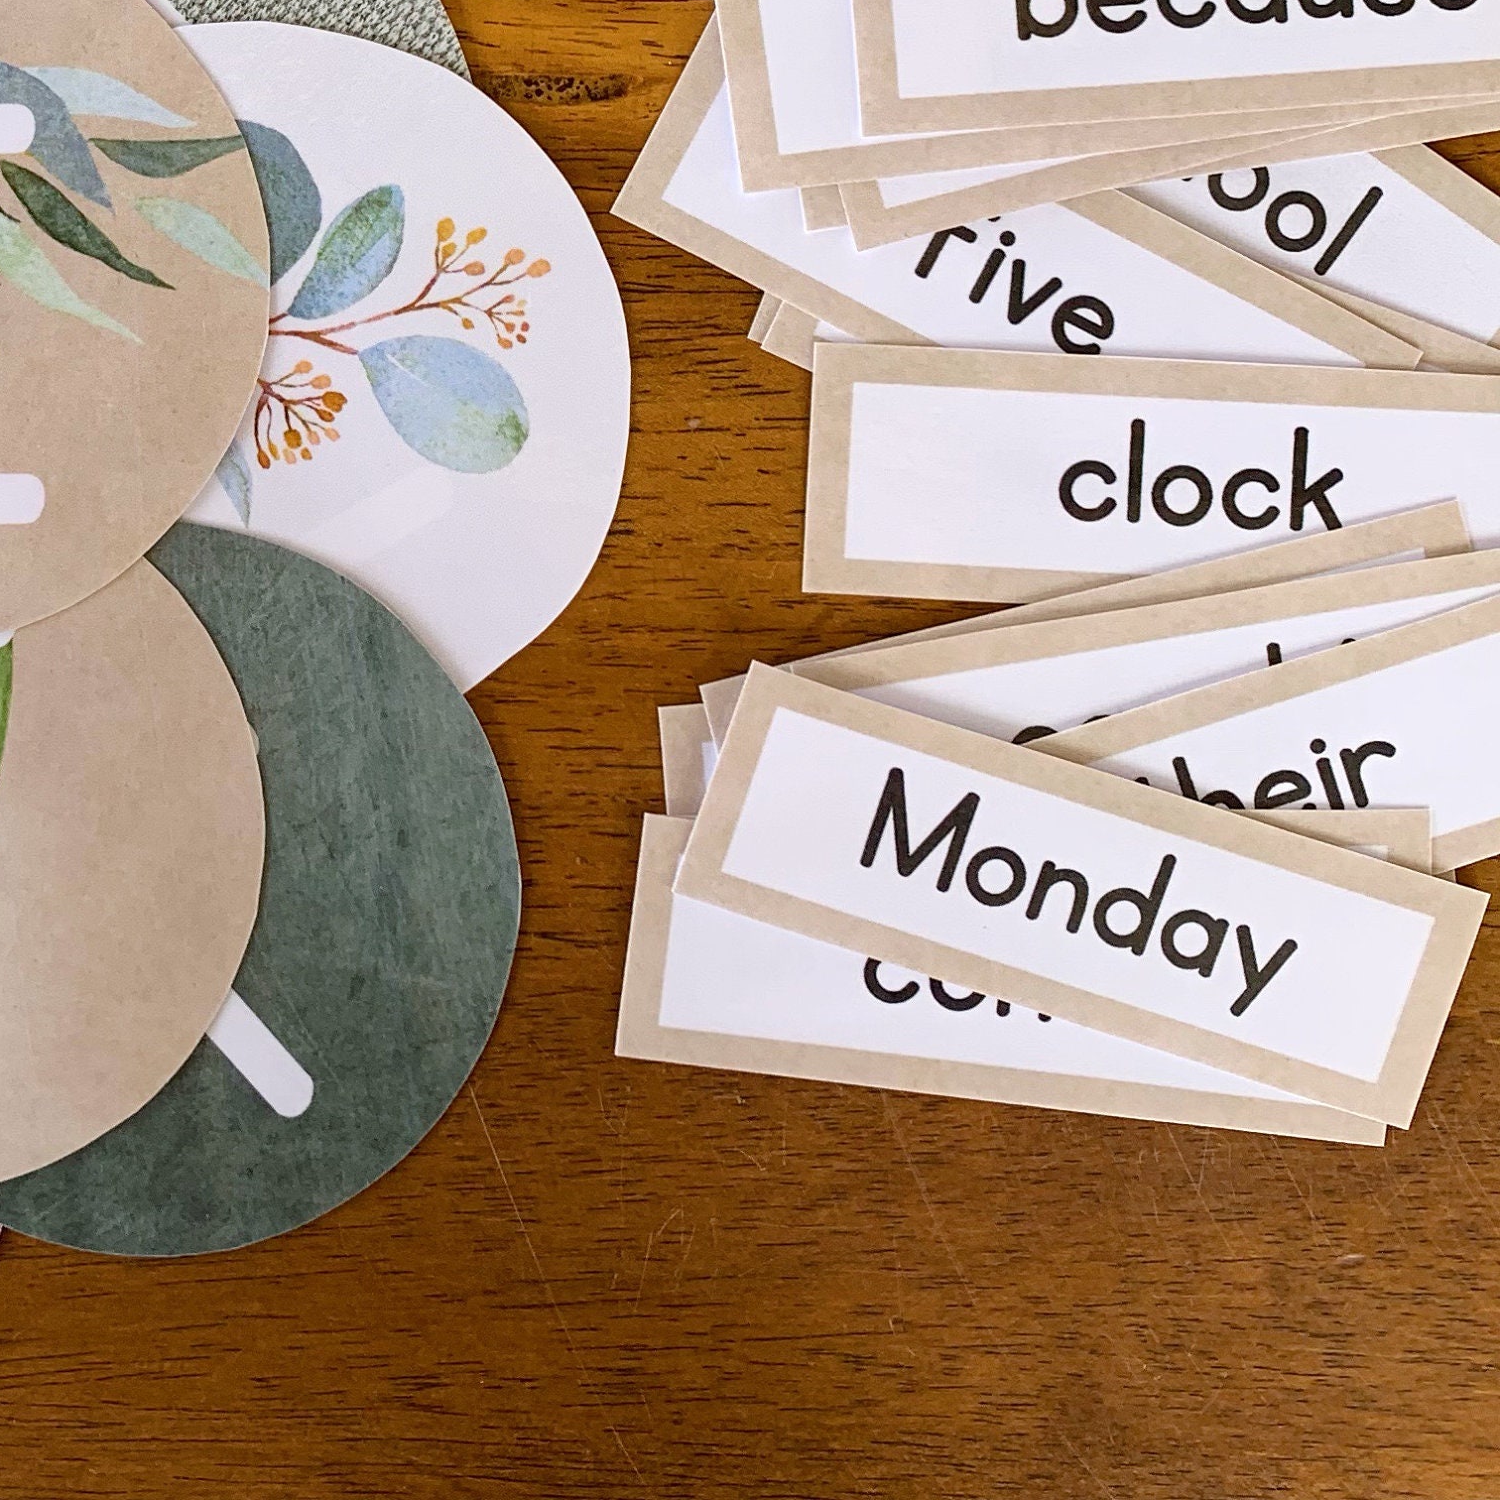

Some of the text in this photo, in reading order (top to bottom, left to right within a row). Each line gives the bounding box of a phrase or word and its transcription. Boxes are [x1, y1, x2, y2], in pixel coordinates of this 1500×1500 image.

[1181, 166, 1385, 277] ool
[1057, 418, 1344, 531] clock
[859, 766, 1298, 1018] Monday
